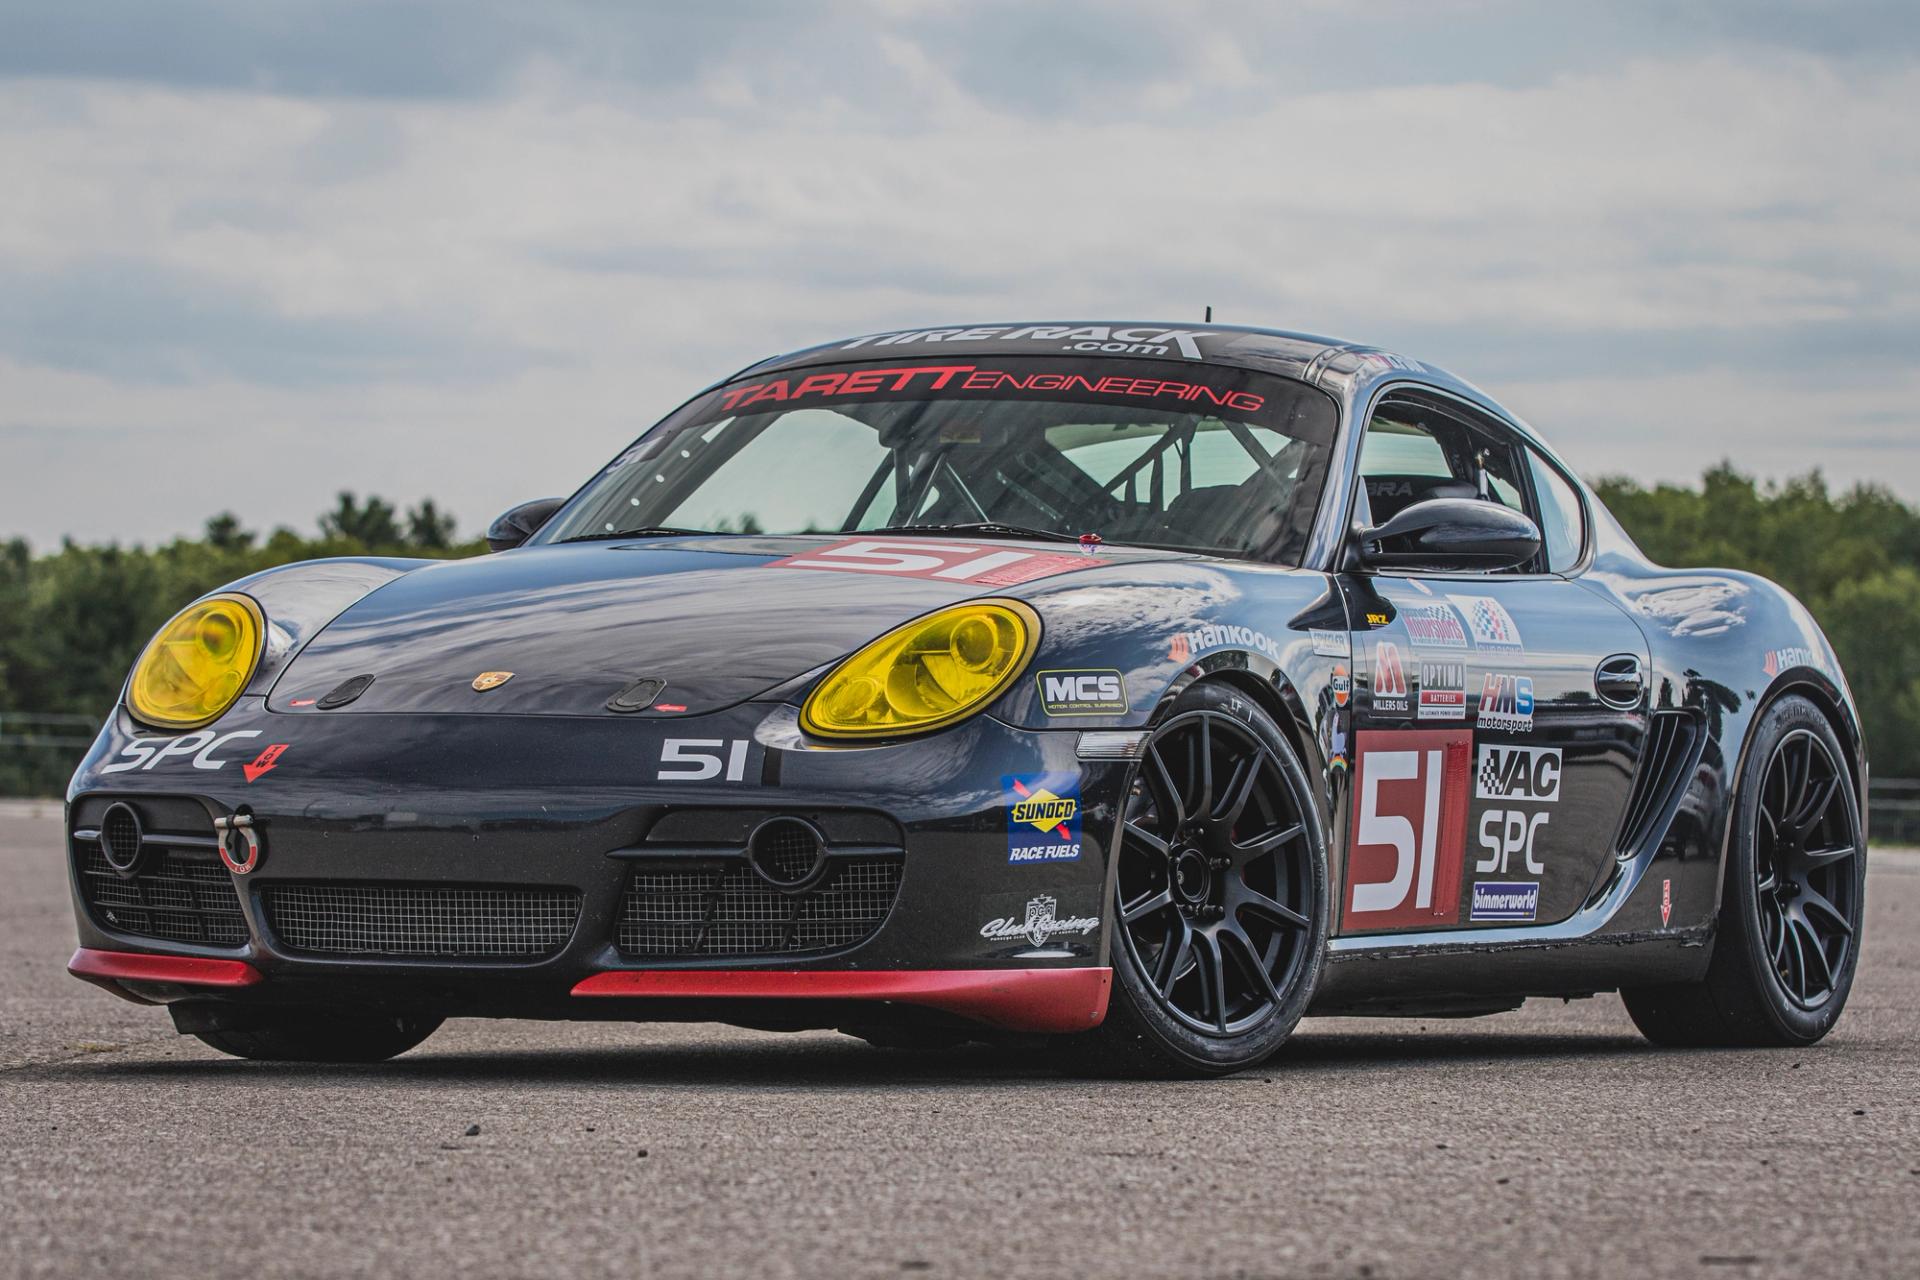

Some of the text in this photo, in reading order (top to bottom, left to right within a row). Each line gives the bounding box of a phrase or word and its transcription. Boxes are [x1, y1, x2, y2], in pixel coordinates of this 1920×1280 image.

[1062, 341, 1168, 355] .com
[721, 365, 1265, 412] TARETT ENGINEERING
[787, 541, 1035, 580] 51
[1333, 678, 1350, 692] Gulf
[1423, 664, 1463, 687] OPTIMA
[1045, 676, 1120, 701] MCS
[1430, 694, 1456, 703] BATTERIES
[1479, 673, 1534, 716] HMS
[1373, 700, 1408, 711] MILLERS OILS
[1477, 717, 1532, 734] motorsport
[101, 730, 262, 774] SPC
[256, 745, 281, 768] TOW
[657, 738, 749, 781] 51
[1486, 749, 1560, 797] VAC
[1015, 803, 1074, 820] SUNOCO
[1351, 750, 1442, 912] 51
[1476, 810, 1549, 874] SPC
[1010, 844, 1079, 861] RACE FUELS
[1474, 889, 1536, 909] bimmerworld
